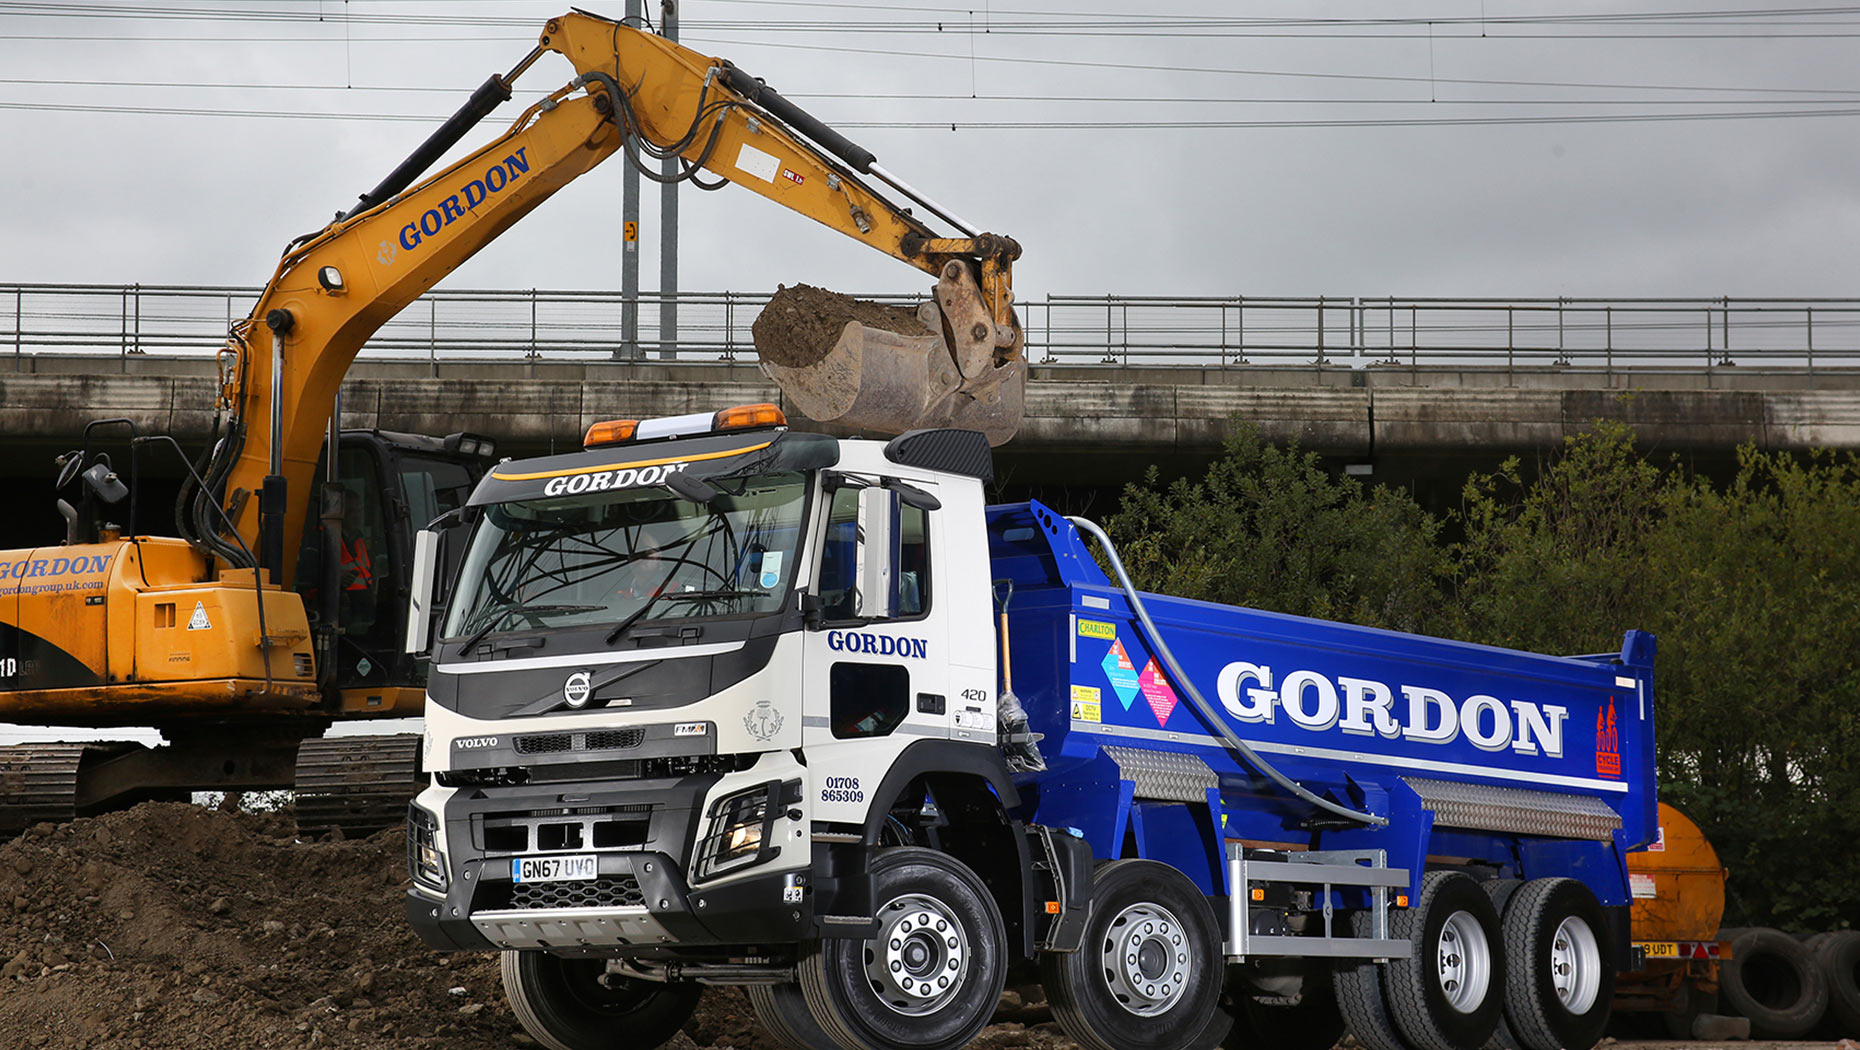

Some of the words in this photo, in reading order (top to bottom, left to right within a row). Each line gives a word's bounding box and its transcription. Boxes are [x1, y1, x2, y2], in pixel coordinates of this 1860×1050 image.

[399, 146, 530, 251] GORDON
[544, 463, 689, 496] GORDON
[0, 555, 112, 579] GORDON
[1079, 622, 1115, 635] CHARLTON
[828, 631, 927, 659] GORDON
[961, 689, 987, 702] 420
[1217, 661, 1569, 758] GORDON
[456, 737, 498, 749] VOLVO
[826, 776, 859, 789] 01708
[821, 789, 864, 803] 865309
[523, 860, 560, 878] GN67
[1653, 943, 1673, 955] UDT
